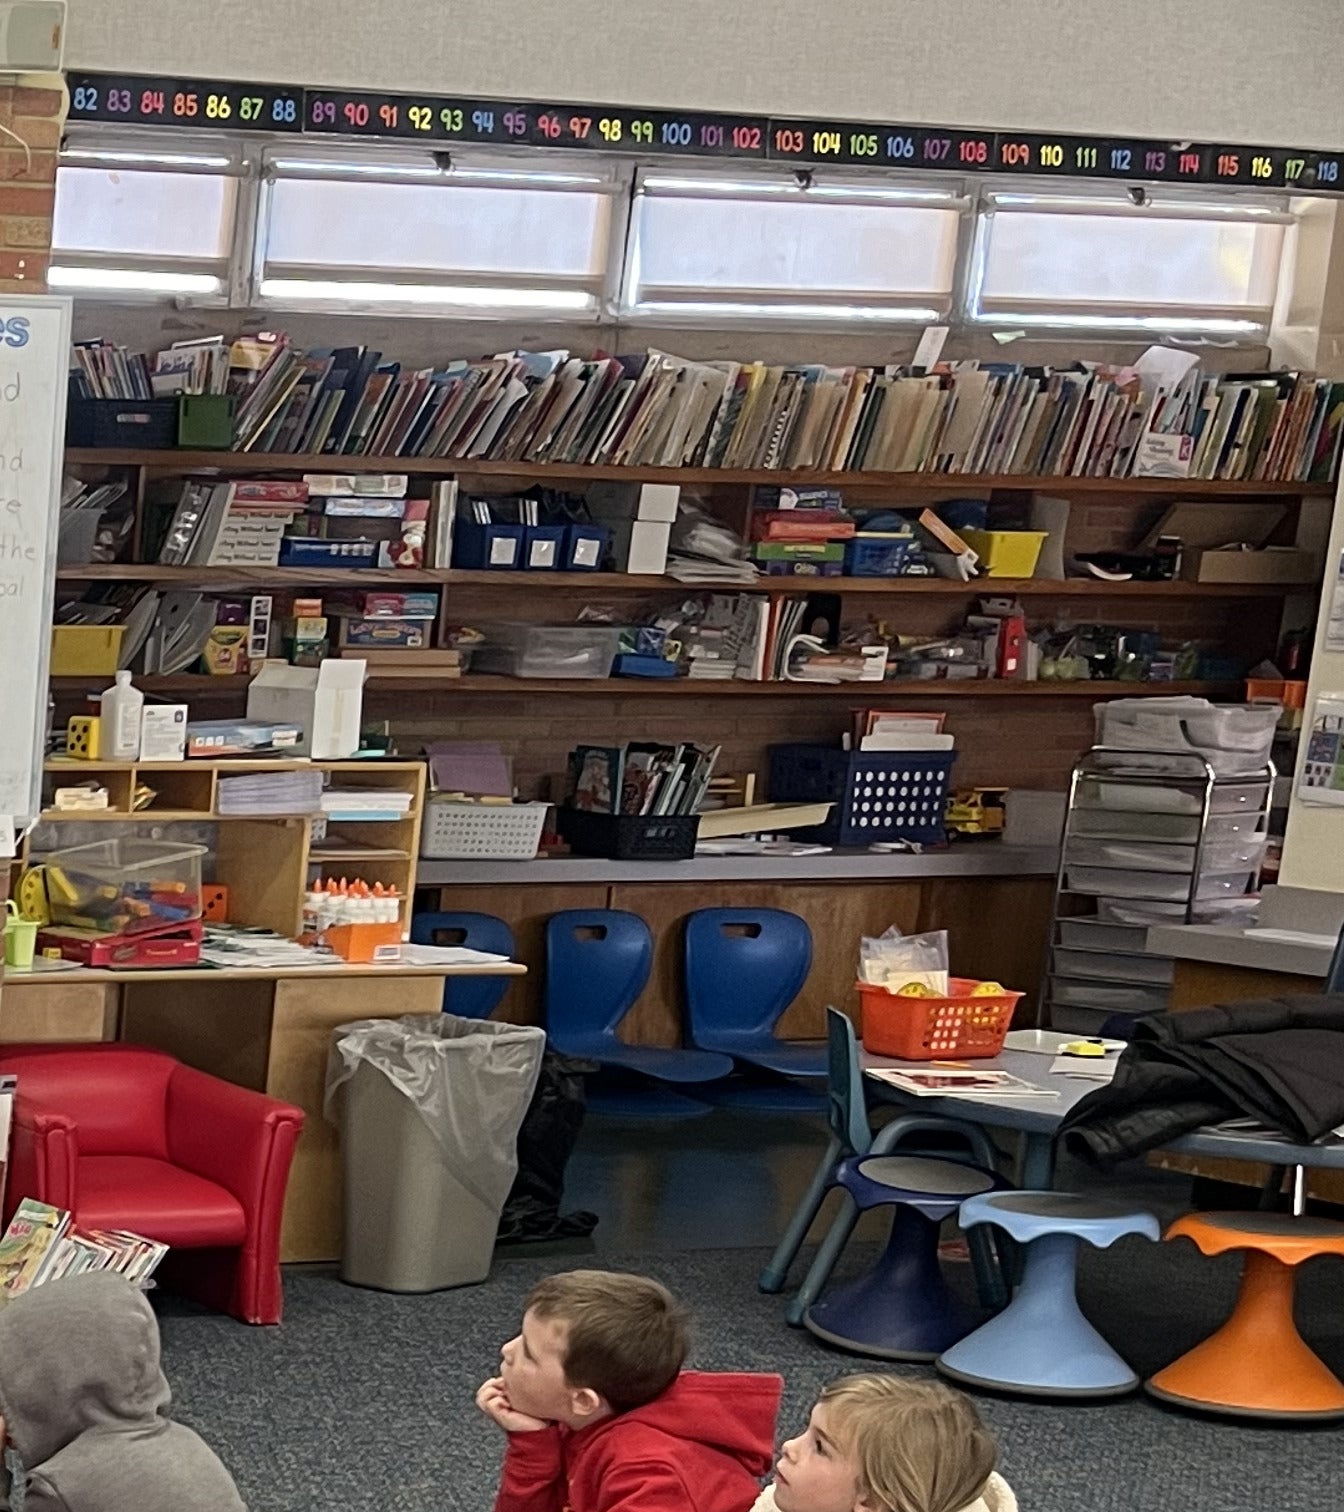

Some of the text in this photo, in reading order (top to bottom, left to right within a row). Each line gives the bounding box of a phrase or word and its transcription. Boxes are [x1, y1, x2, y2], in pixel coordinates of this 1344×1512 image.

[72, 86, 1339, 182] 82 84 85 86 87 88 89 90 91 92 93 94 96 97 98 99 100 102 103 104 105 106 108 109 110 116 118
